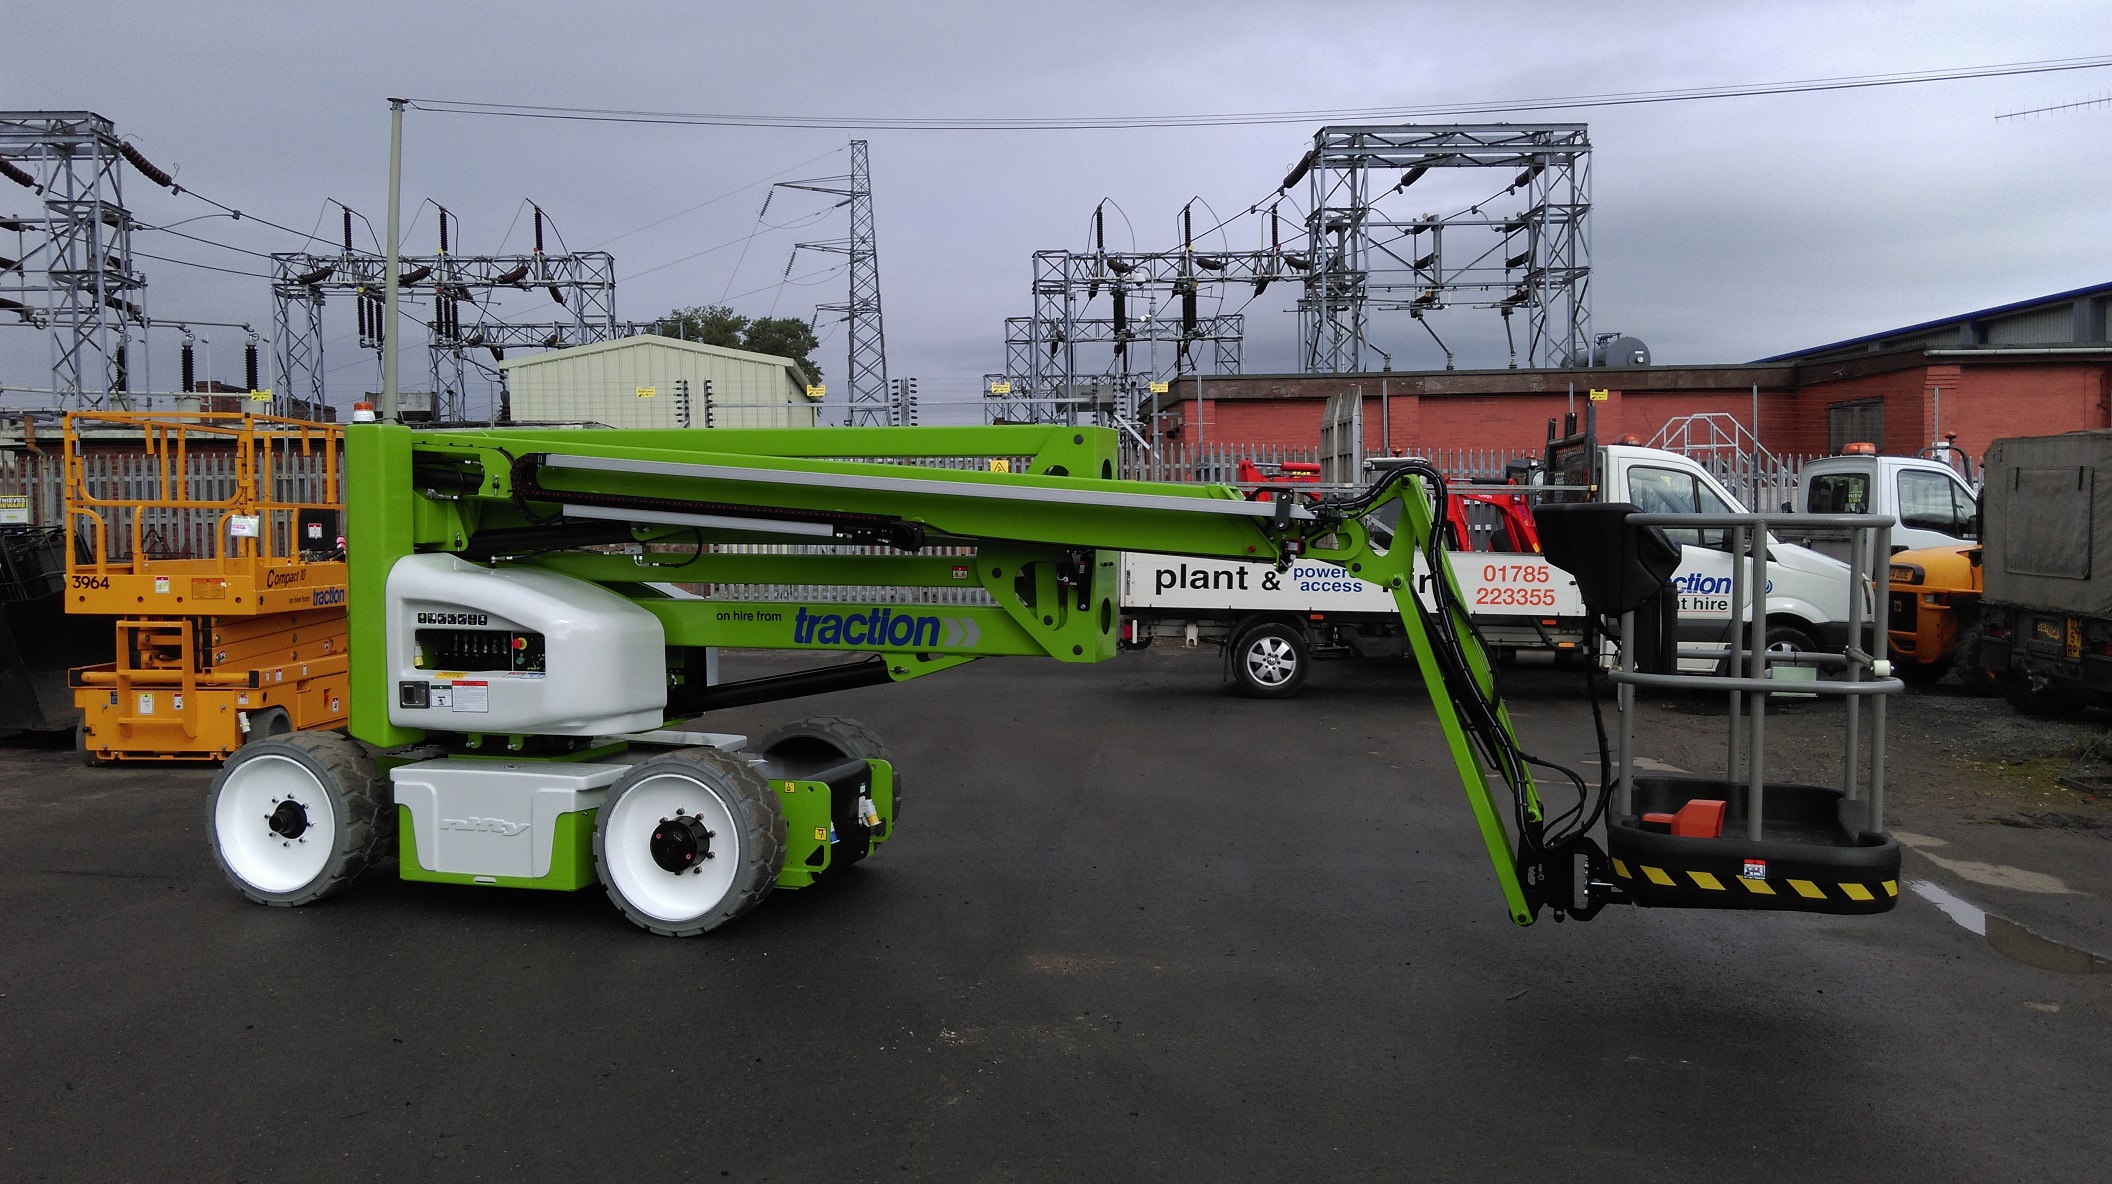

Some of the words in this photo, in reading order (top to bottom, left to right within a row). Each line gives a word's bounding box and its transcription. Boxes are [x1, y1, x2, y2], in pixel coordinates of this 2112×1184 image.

[72, 575, 110, 589] 3964
[267, 569, 299, 588] Compact
[1155, 564, 1248, 595] plant
[1262, 571, 1281, 591] &
[1294, 567, 1357, 581] power
[1483, 565, 1550, 583] 01785
[1668, 573, 1732, 594] ction
[313, 586, 345, 606] traction
[1300, 581, 1363, 592] access
[1476, 587, 1556, 606] 223355
[1693, 597, 1728, 610] hire
[716, 612, 731, 621] on
[733, 611, 754, 621] hire
[757, 611, 782, 621] from
[794, 607, 940, 647] traction
[440, 817, 530, 836] nifty
